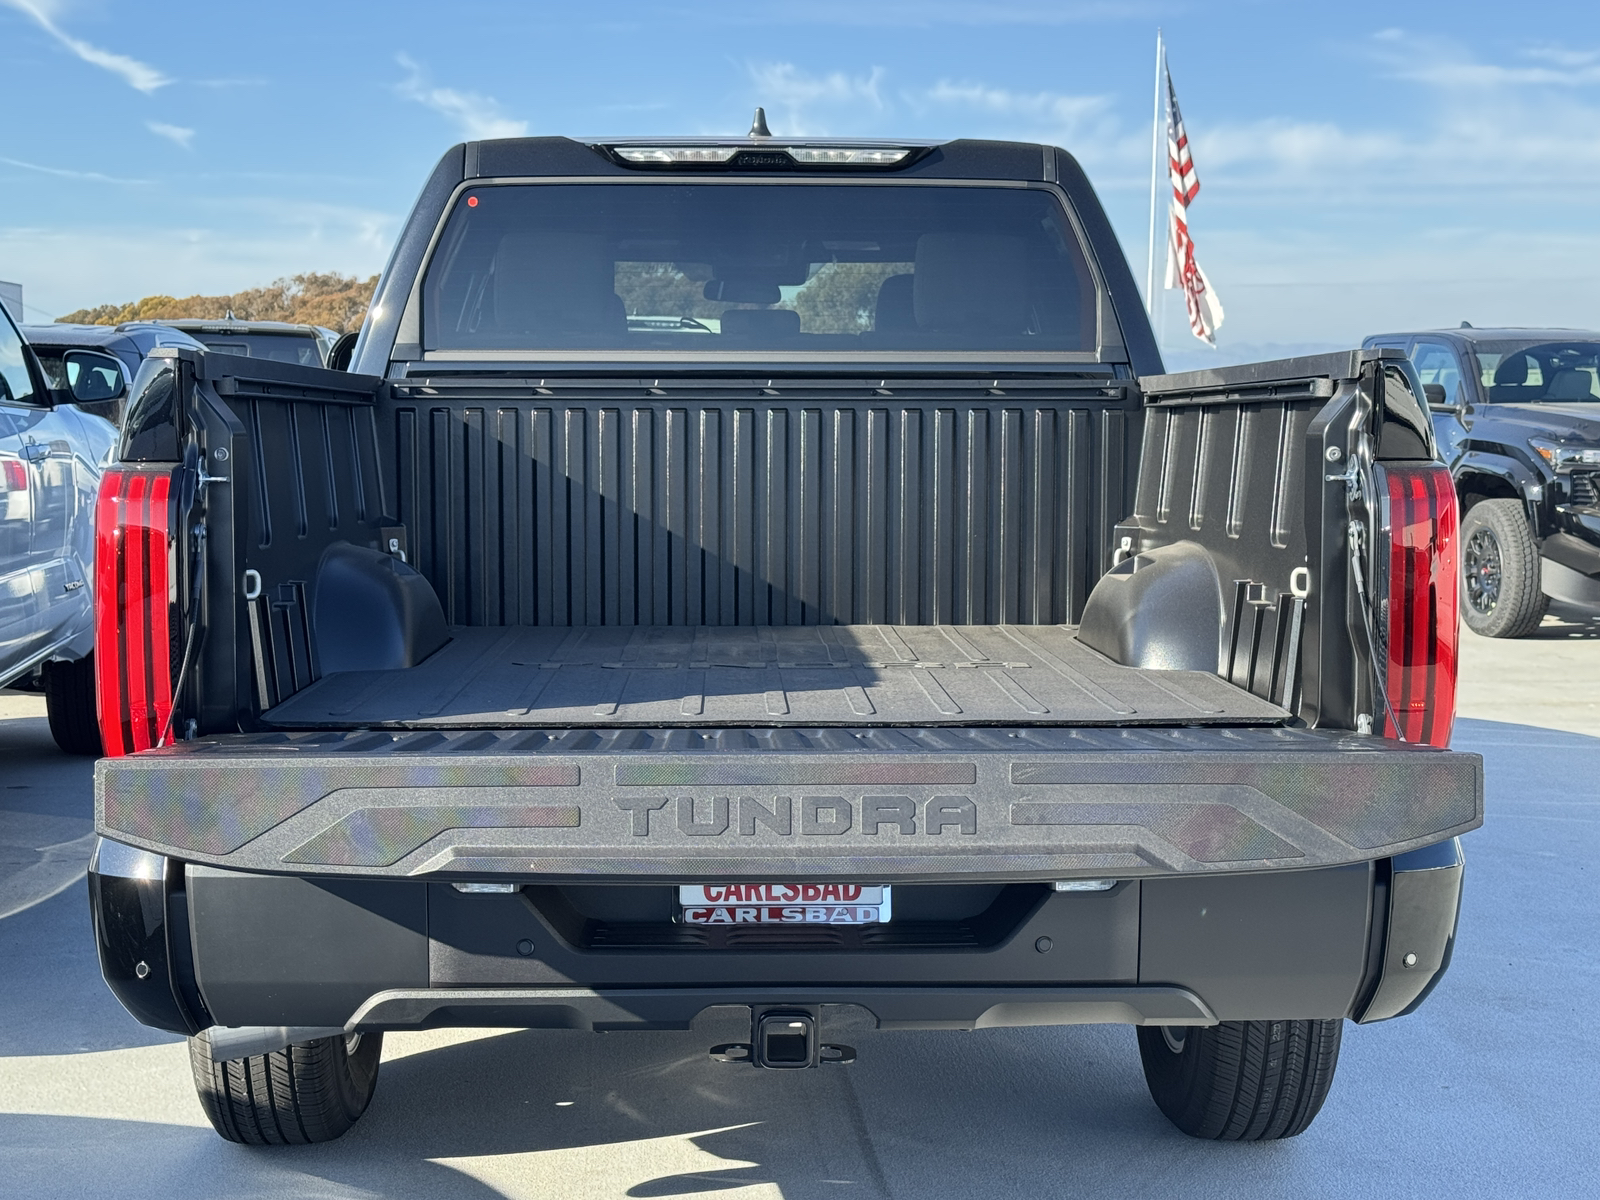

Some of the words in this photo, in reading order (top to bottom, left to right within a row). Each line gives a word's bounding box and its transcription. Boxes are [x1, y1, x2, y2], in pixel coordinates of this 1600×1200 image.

[612, 795, 977, 836] TUNDRA
[703, 884, 863, 902] CARLSBAD
[684, 907, 878, 923] CARLSBAD
